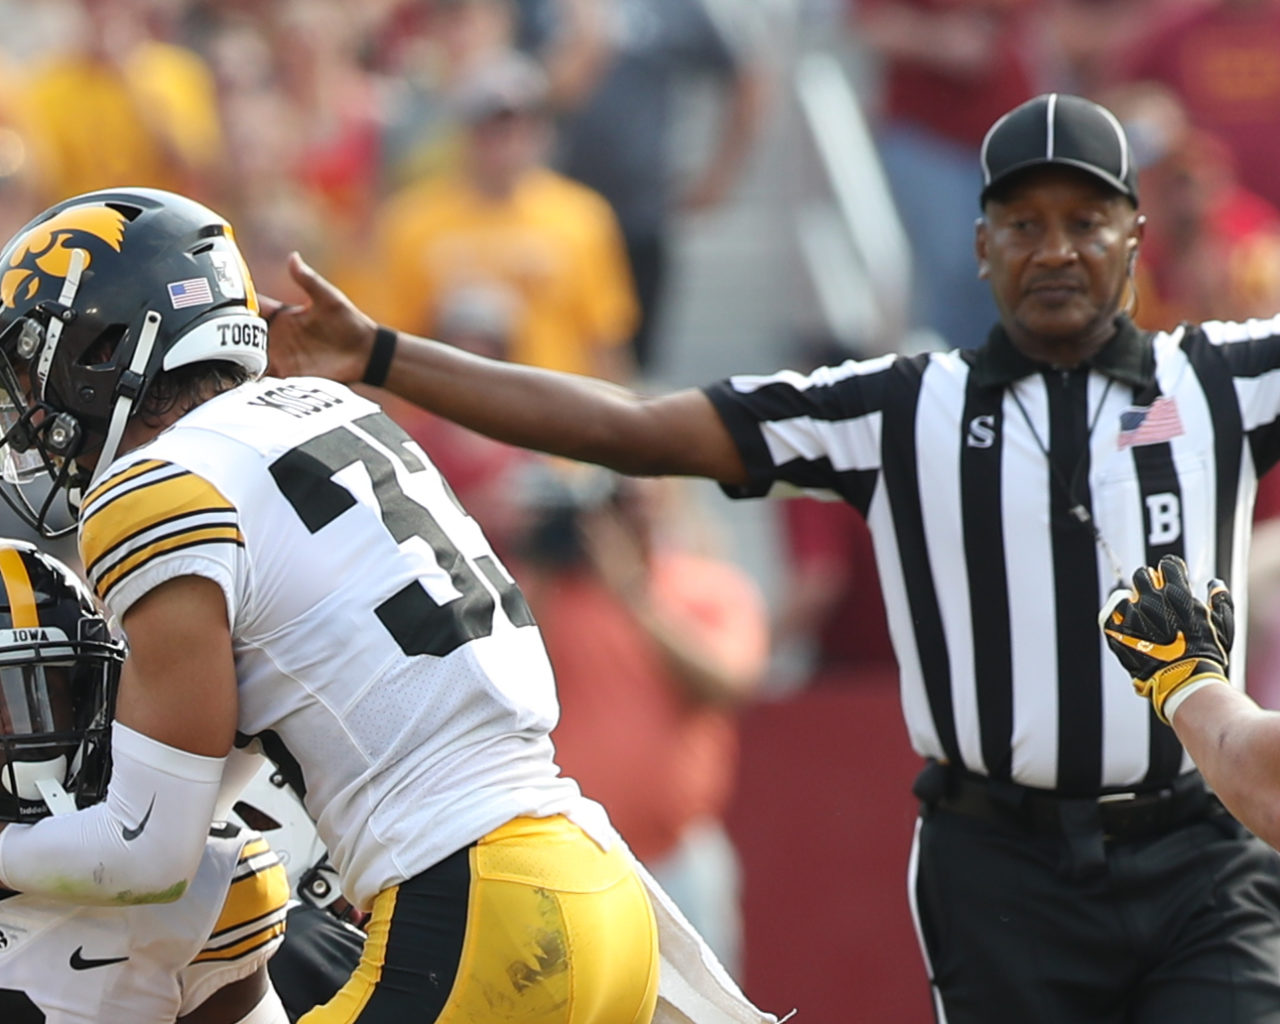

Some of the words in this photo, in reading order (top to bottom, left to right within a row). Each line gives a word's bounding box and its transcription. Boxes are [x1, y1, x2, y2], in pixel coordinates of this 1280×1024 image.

[967, 415, 996, 448] S
[1146, 492, 1181, 546] B
[12, 629, 50, 642] IOWA
